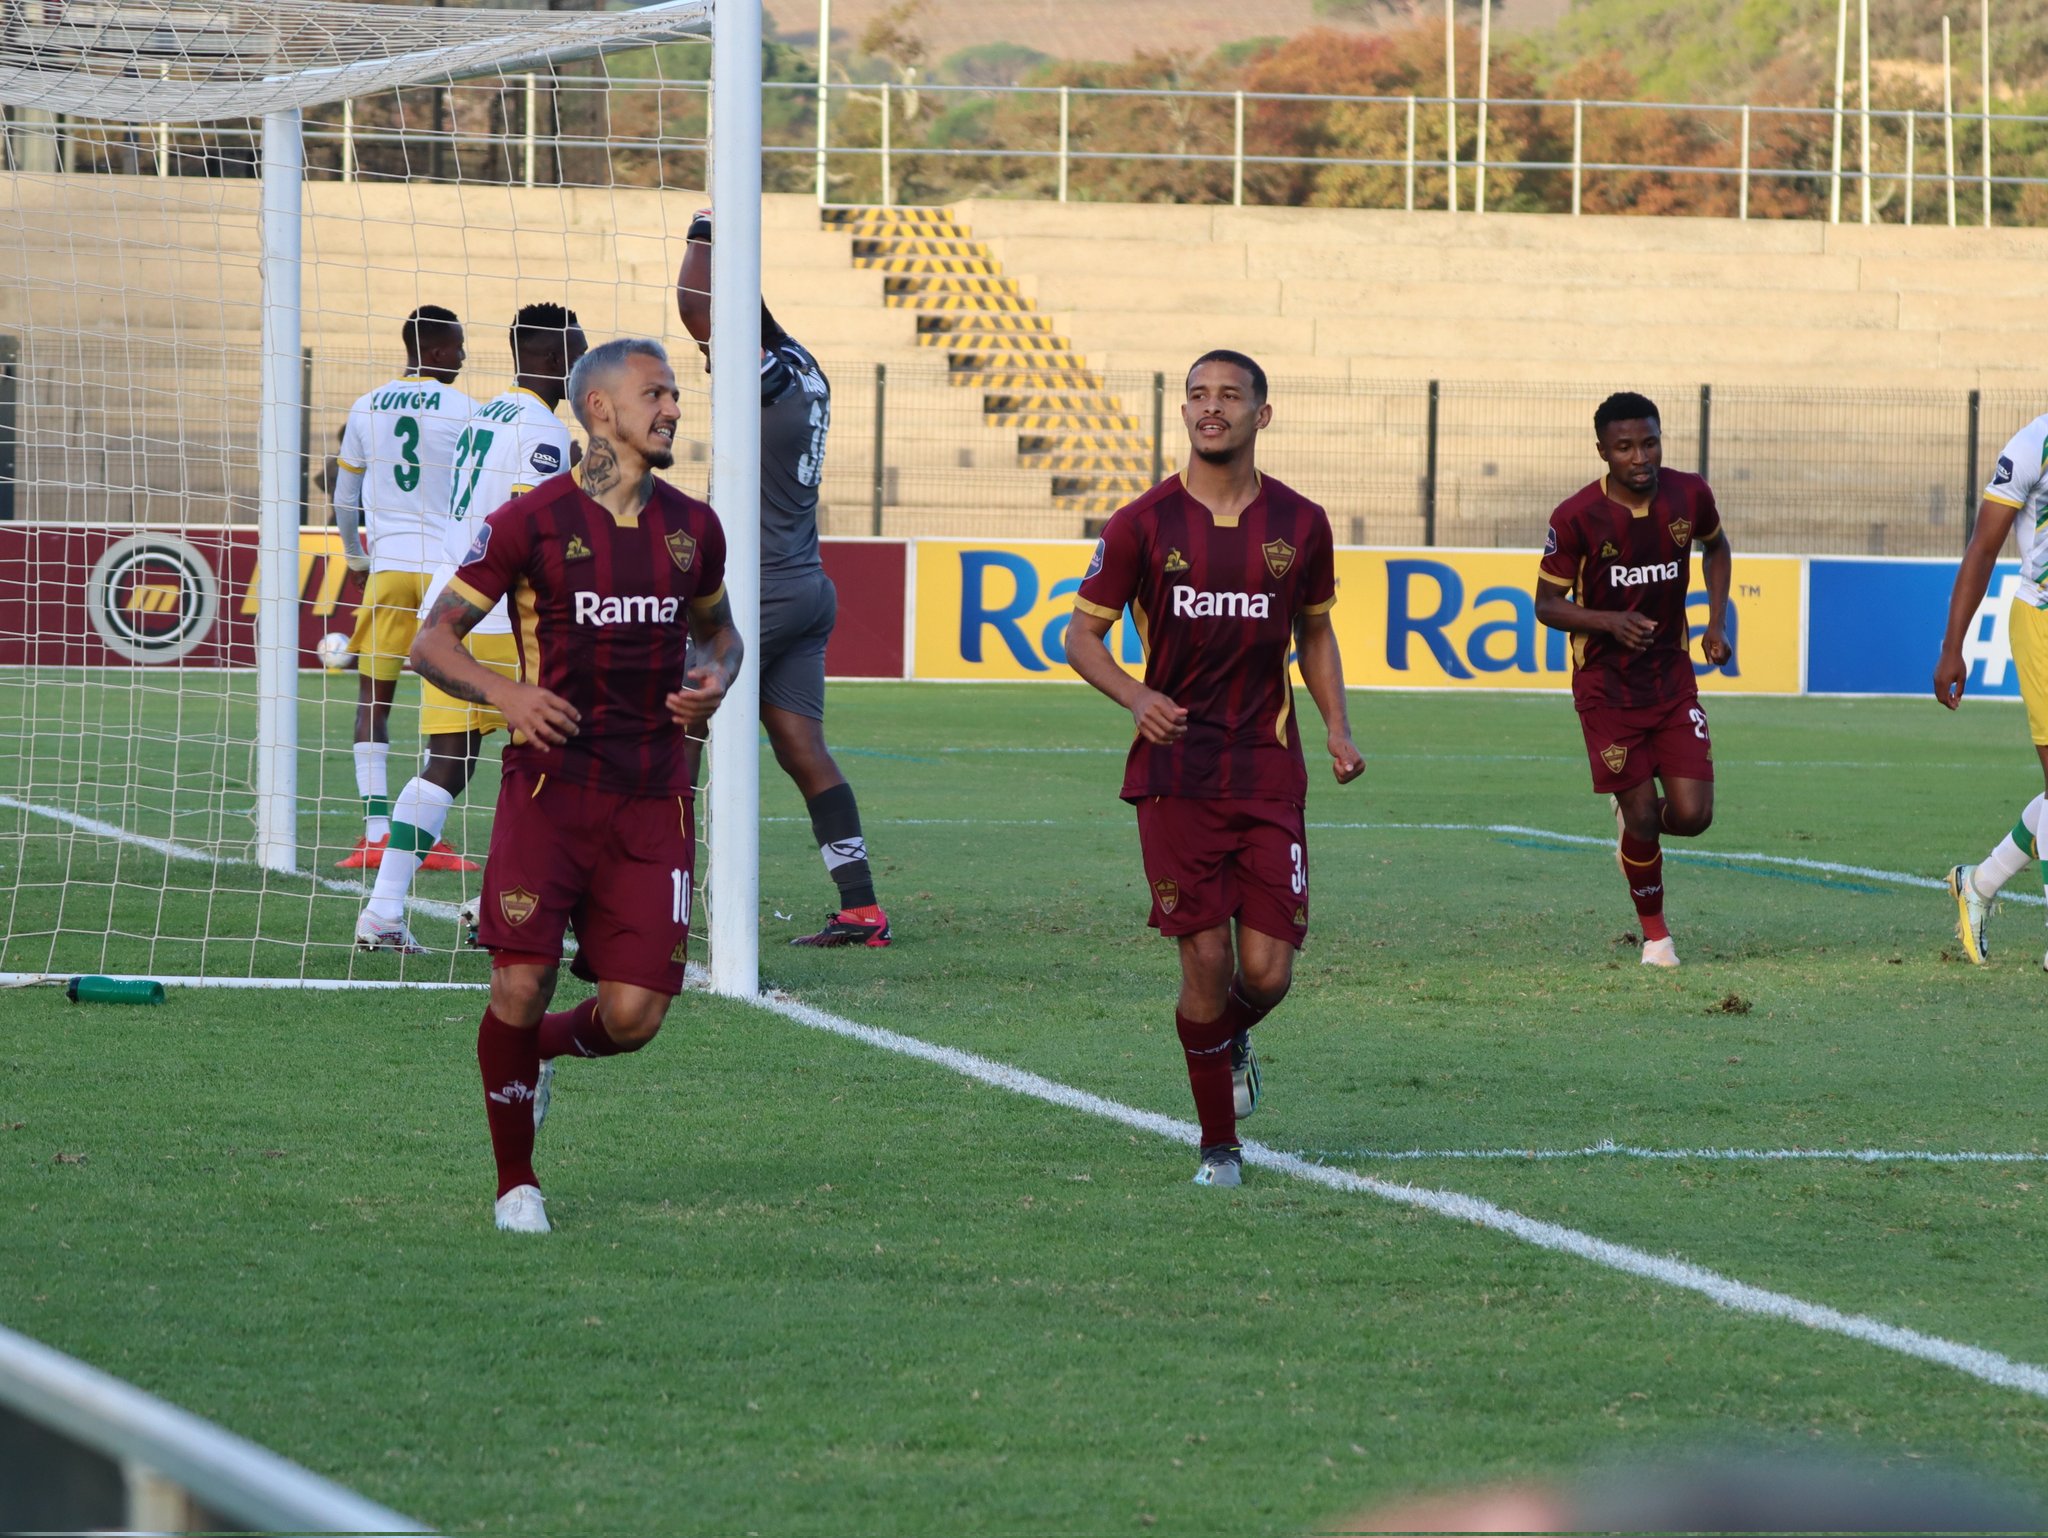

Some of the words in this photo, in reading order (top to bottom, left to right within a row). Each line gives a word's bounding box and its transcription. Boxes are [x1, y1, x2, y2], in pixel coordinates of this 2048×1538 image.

[370, 391, 441, 411] LUNGA
[393, 415, 420, 492] 3
[1610, 560, 1679, 588] Rama
[574, 591, 679, 627] Rama
[1173, 585, 1269, 619] Rama
[671, 868, 691, 926] 10
